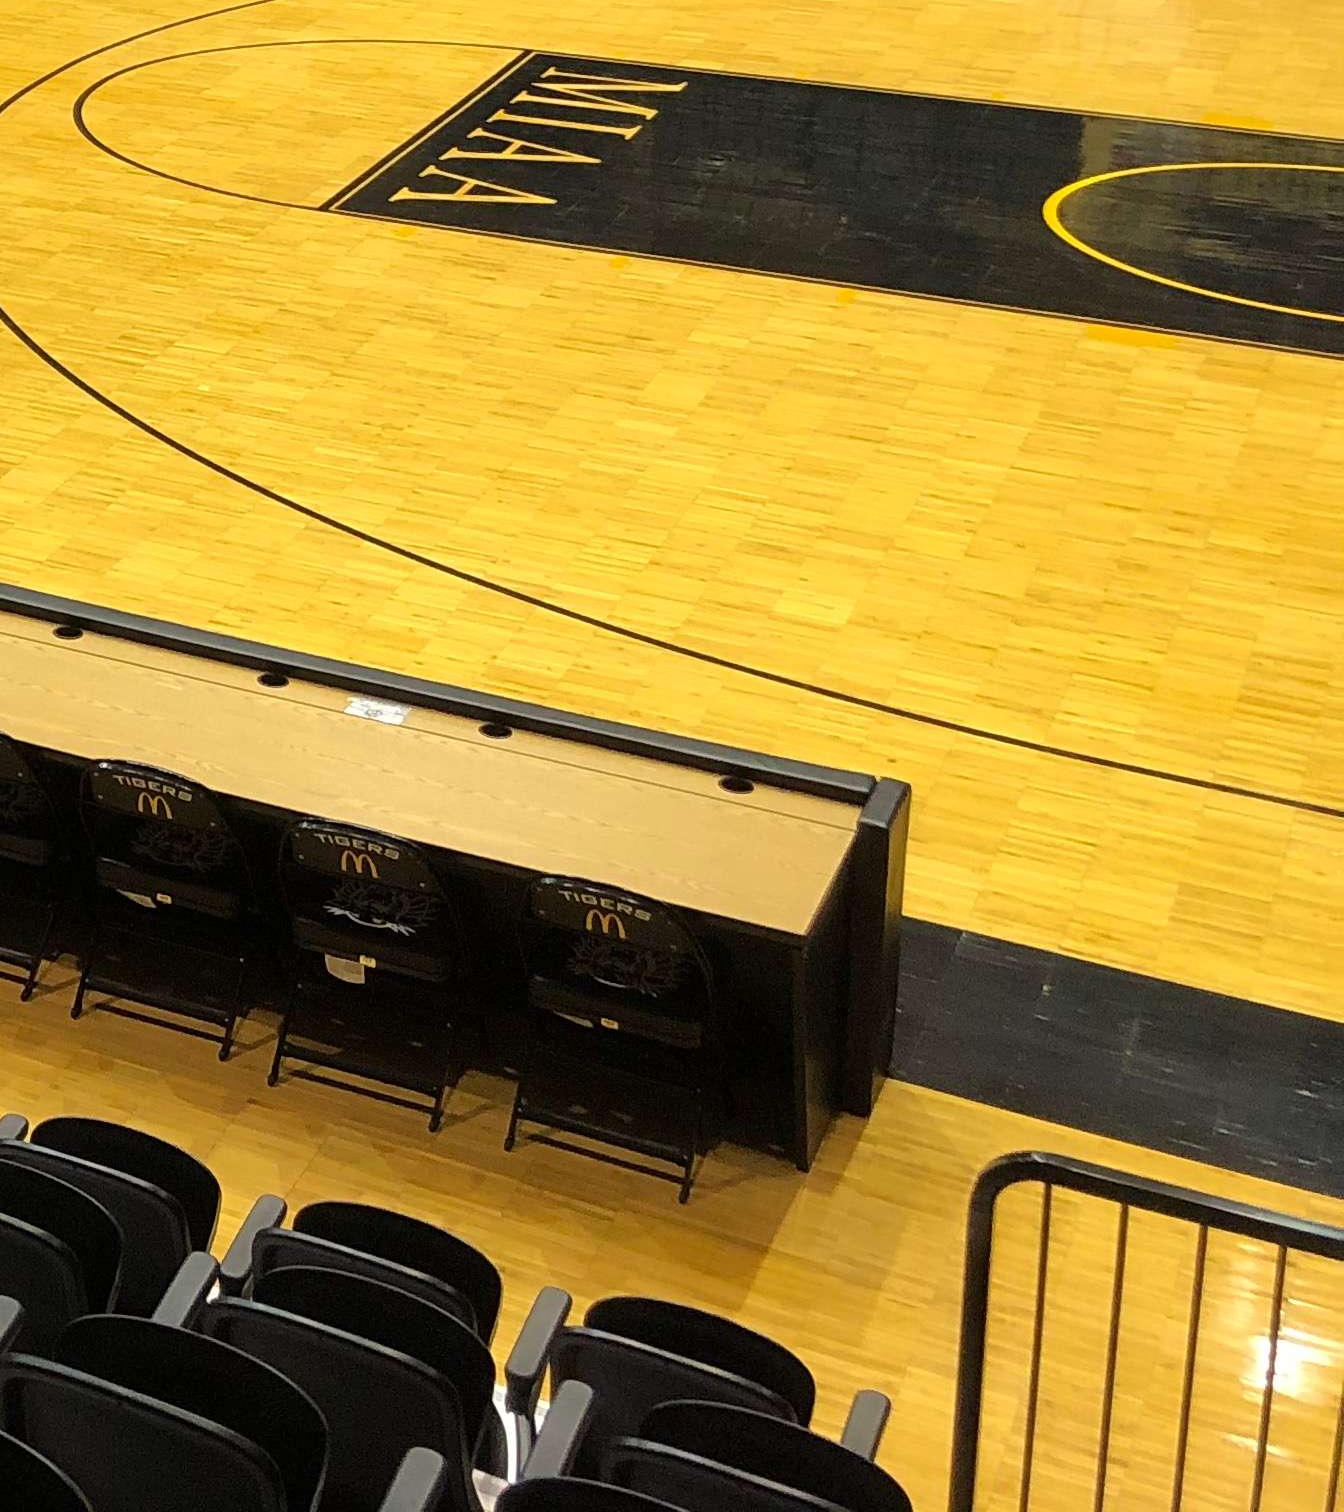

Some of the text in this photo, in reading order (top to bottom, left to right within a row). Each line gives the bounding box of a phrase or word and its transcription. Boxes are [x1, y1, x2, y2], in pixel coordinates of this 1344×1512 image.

[388, 66, 688, 205] MIAA
[113, 773, 193, 804] TIGERS
[313, 830, 401, 861] TIGERS
[557, 889, 652, 921] TIGERS
